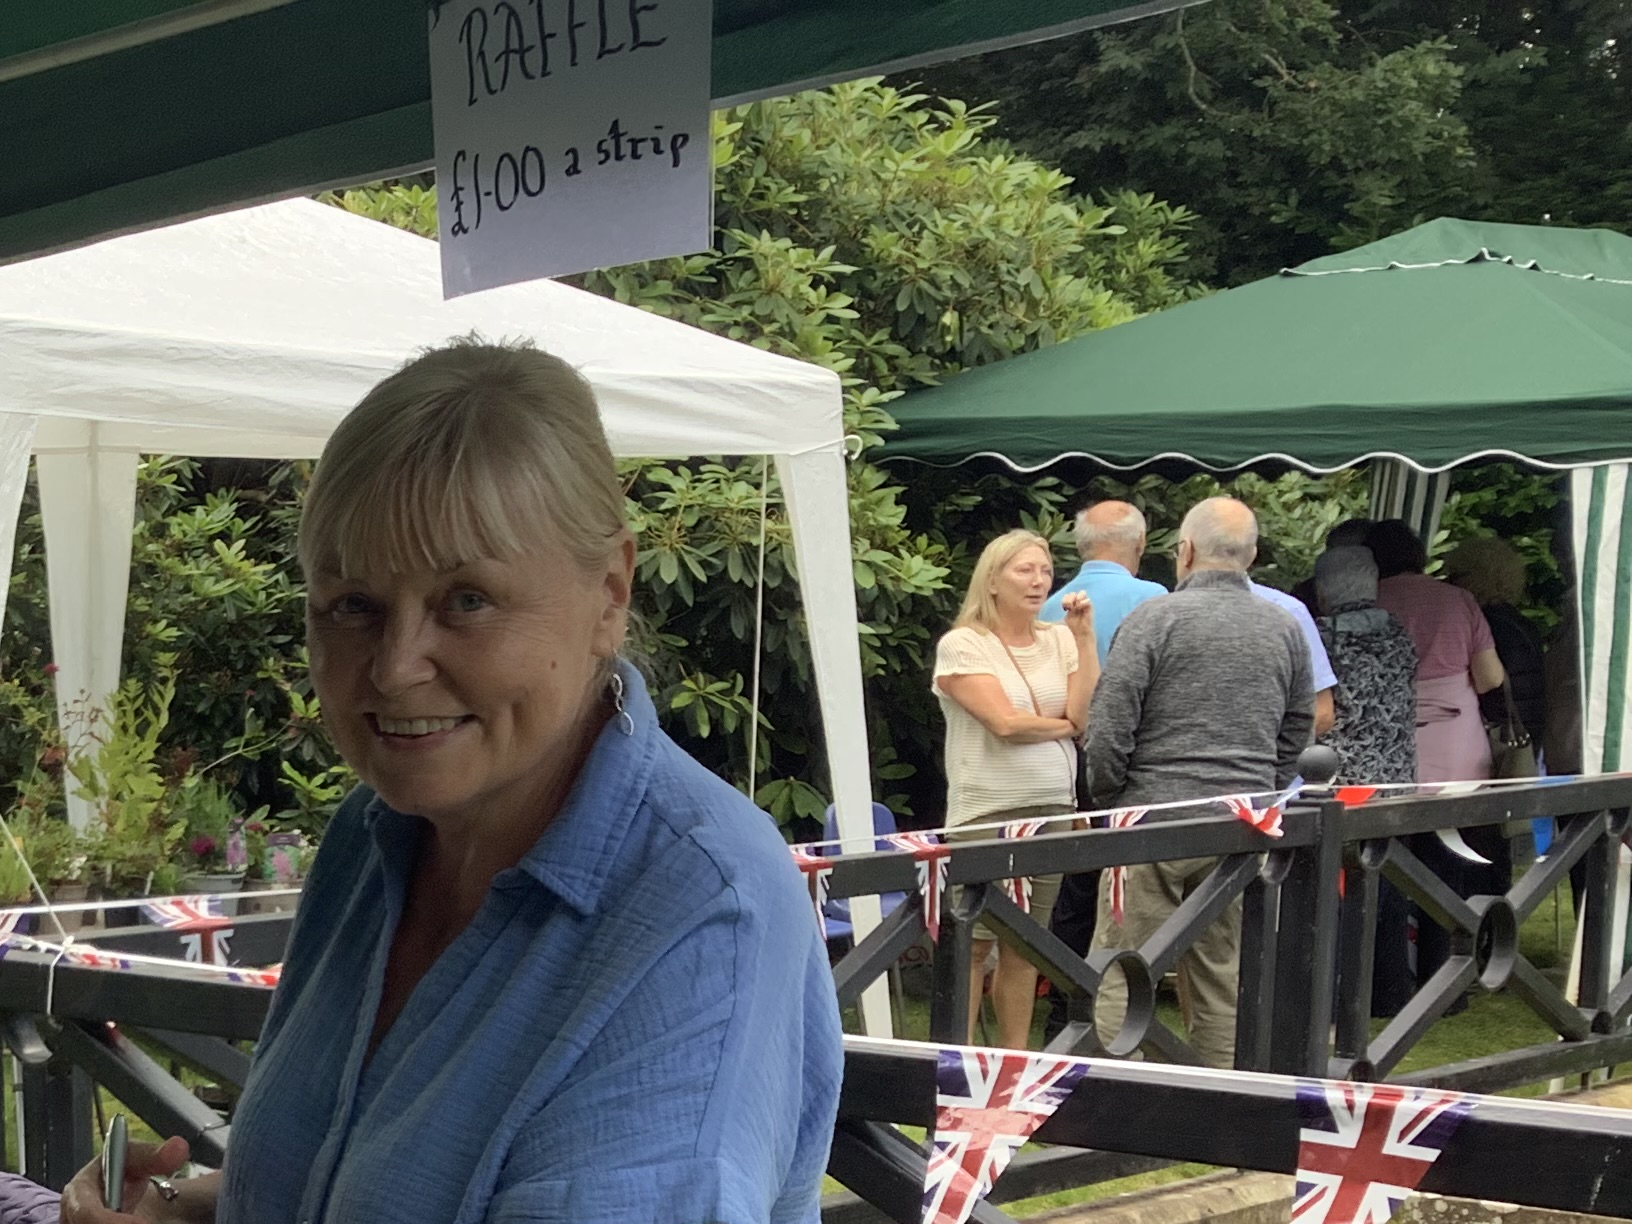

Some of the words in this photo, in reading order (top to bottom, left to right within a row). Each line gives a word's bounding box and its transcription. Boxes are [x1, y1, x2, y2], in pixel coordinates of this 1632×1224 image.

[459, 0, 667, 107] RAFFLE
[564, 148, 582, 177] a
[597, 118, 690, 168] strip
